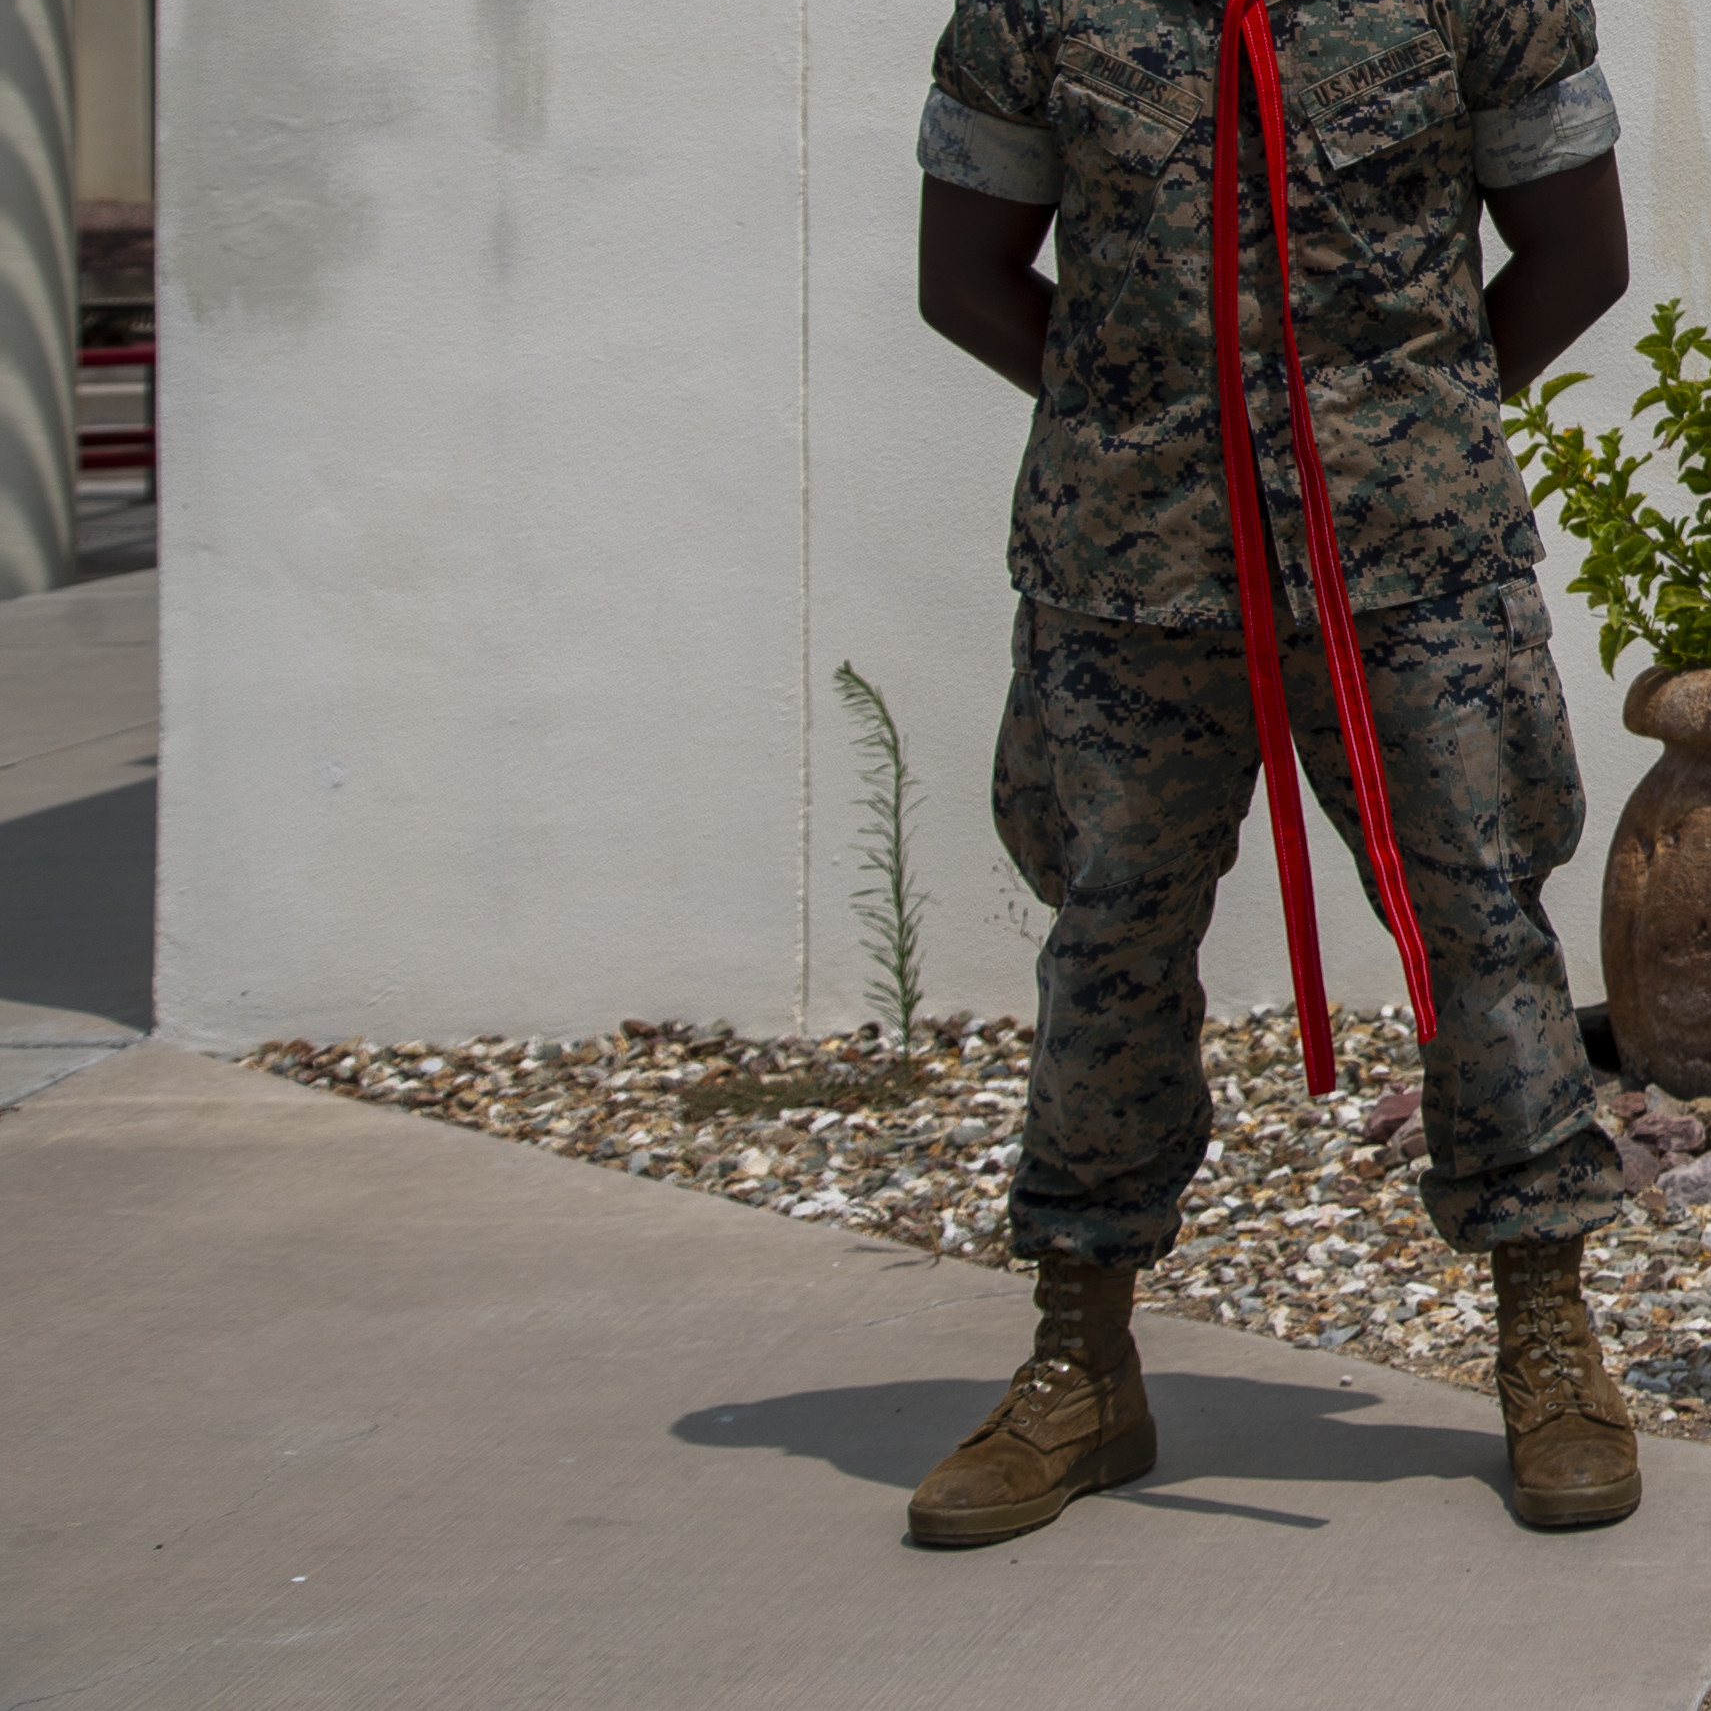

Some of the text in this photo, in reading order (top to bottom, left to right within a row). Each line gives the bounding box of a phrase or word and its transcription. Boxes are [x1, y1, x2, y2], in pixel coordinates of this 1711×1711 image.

[1089, 52, 1168, 103] PHILLIPS
[1313, 39, 1437, 108] U.S. MARINES
